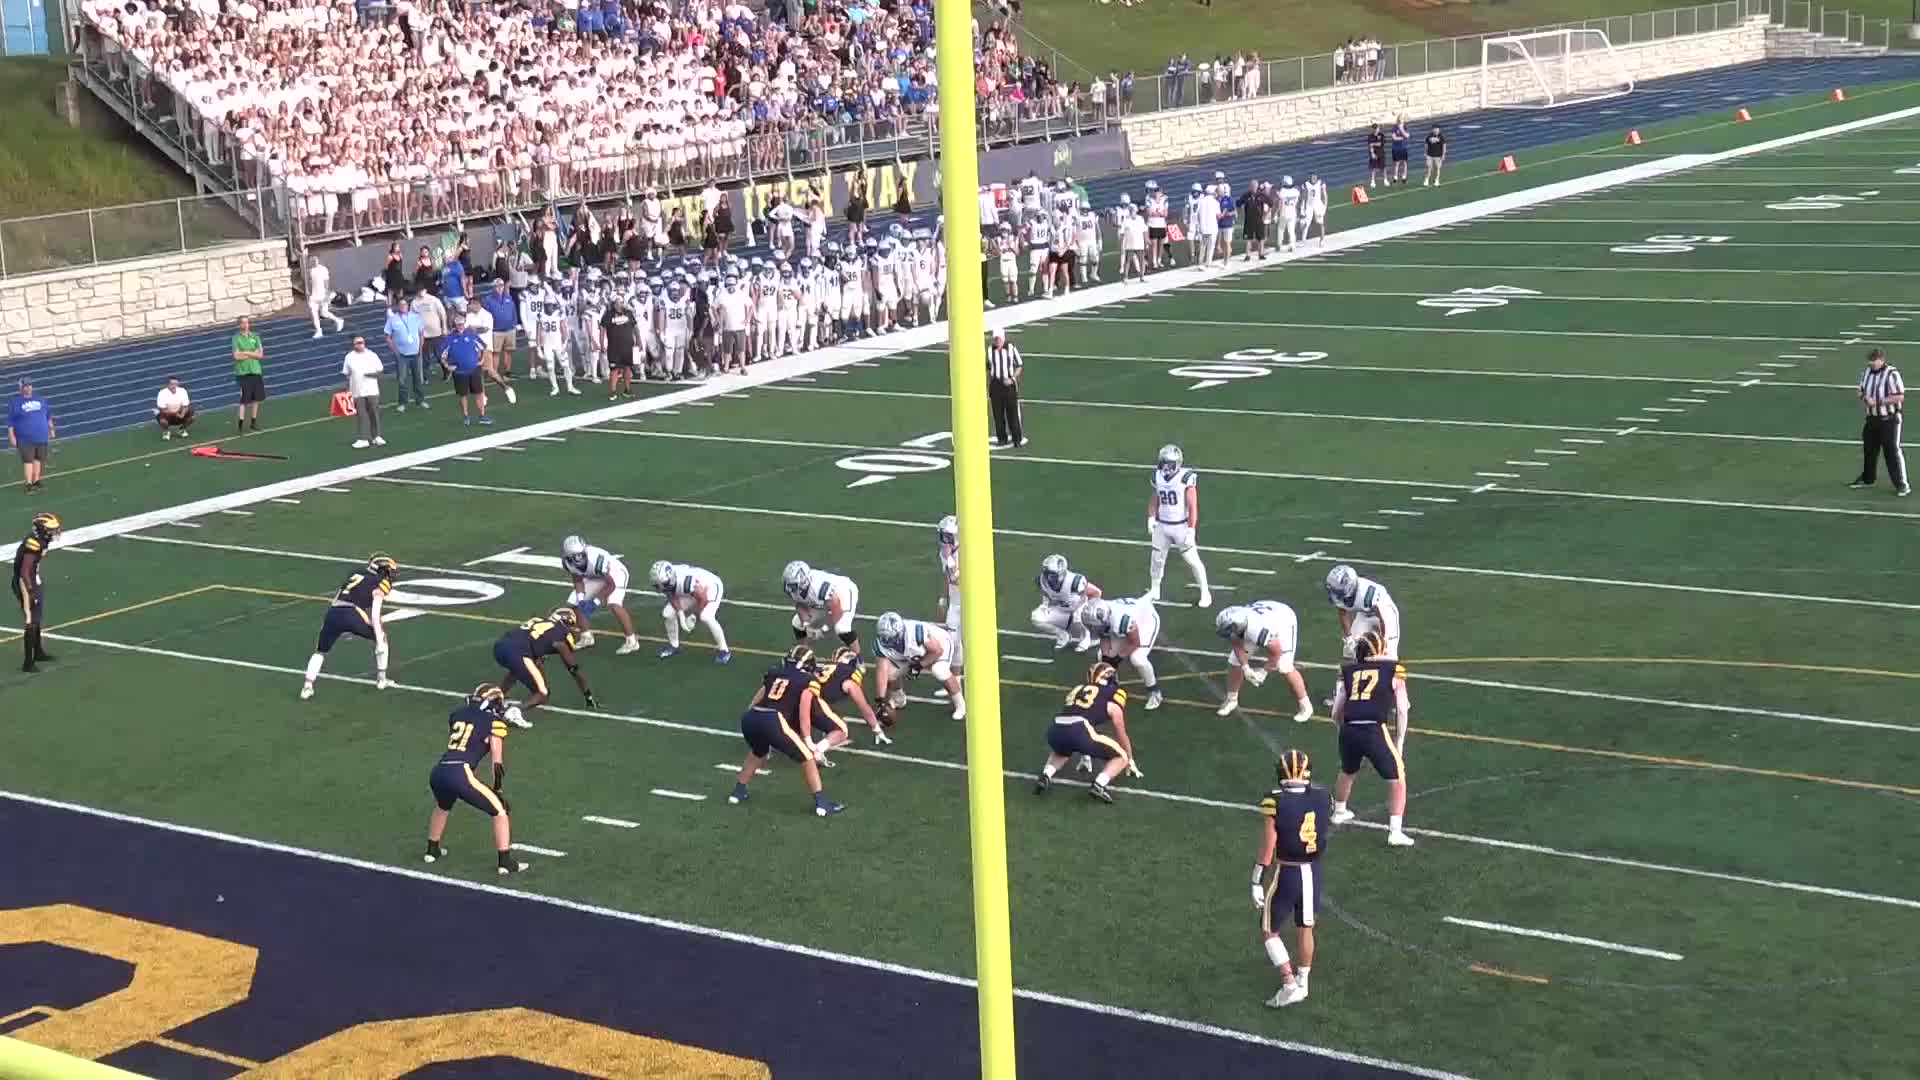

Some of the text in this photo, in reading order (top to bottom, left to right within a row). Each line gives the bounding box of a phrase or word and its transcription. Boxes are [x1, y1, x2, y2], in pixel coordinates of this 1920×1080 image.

[1168, 348, 1328, 379] 30
[1159, 490, 1178, 505] 20
[1350, 669, 1379, 701] 17
[448, 721, 475, 752] 21
[1298, 810, 1318, 854] 4
